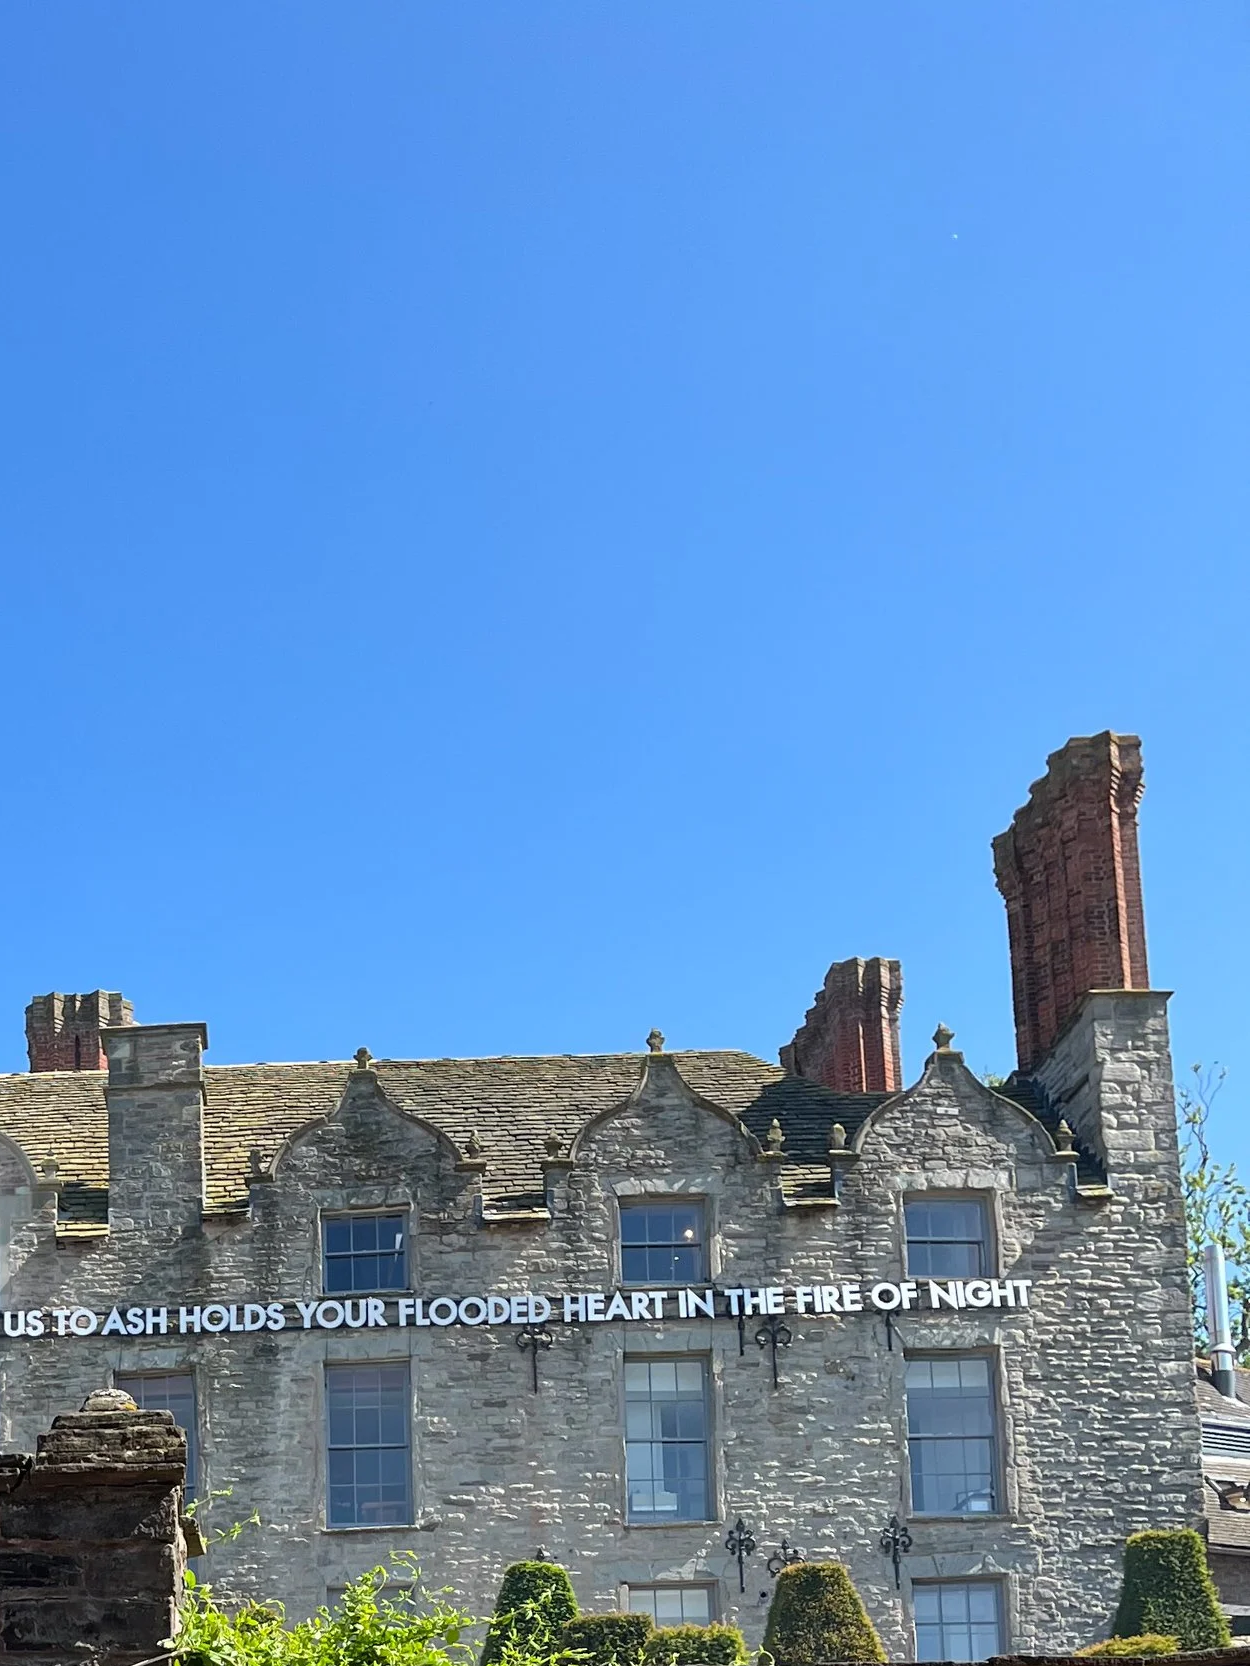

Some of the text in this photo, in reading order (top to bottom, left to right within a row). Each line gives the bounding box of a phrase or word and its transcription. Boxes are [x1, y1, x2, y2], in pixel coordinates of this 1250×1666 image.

[3, 1310, 45, 1337] US
[52, 1308, 97, 1336] TO
[101, 1306, 168, 1336] ASH
[179, 1302, 286, 1334] HOLDS
[296, 1299, 388, 1329] YOUR
[399, 1296, 551, 1327] FLOODED
[563, 1291, 668, 1322] HEART
[678, 1288, 715, 1319] IN
[724, 1286, 786, 1316] THE
[795, 1284, 863, 1314] FIRE
[871, 1281, 917, 1310] OF
[928, 1279, 1033, 1310] NIGHT
